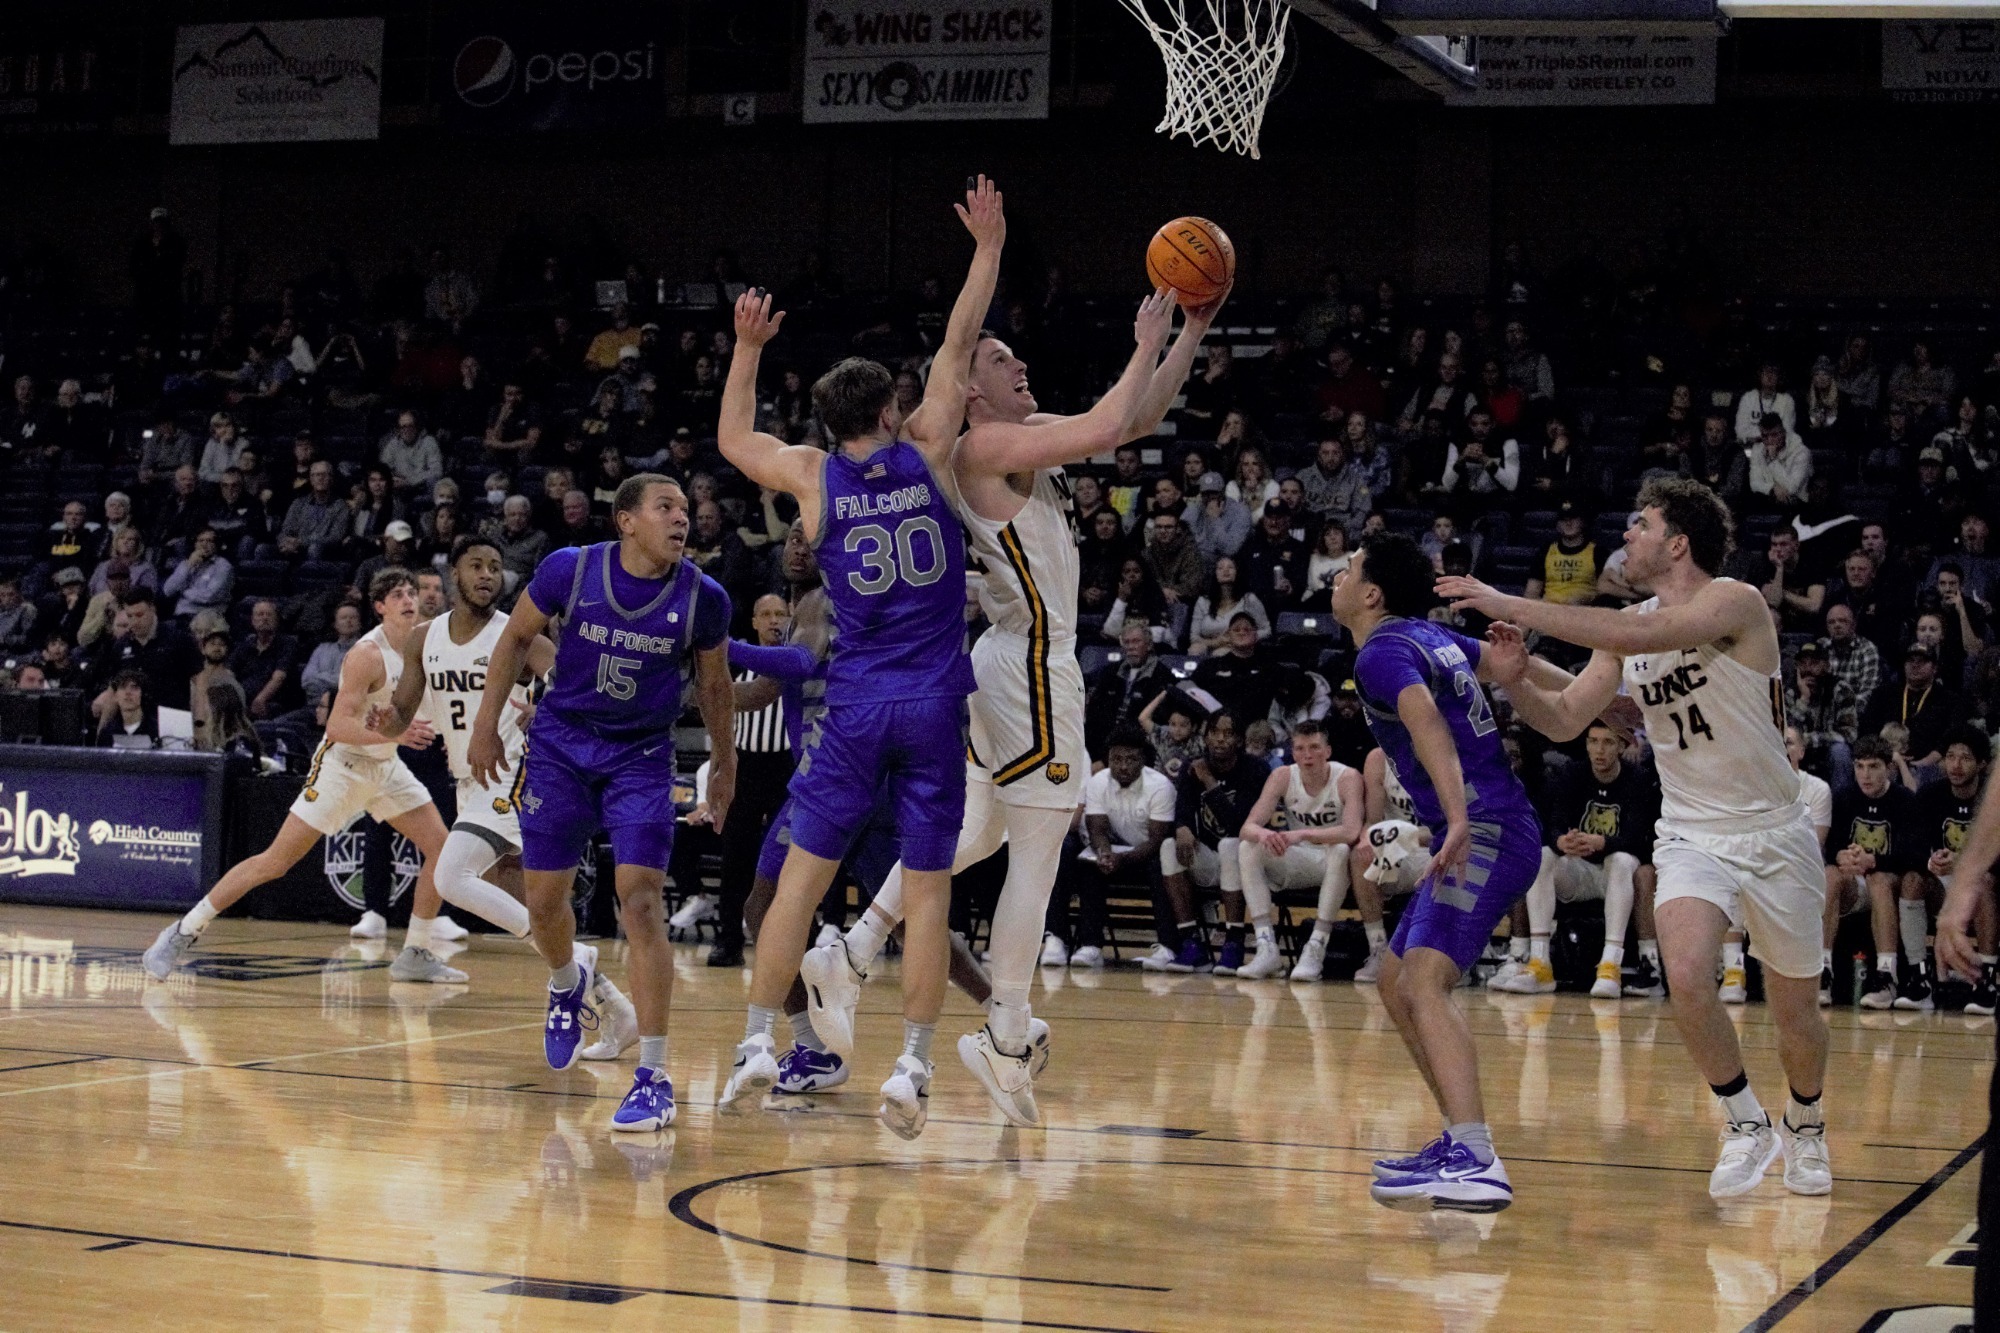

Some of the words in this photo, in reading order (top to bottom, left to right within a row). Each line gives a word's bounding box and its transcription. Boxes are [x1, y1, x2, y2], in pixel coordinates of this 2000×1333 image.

[855, 13, 932, 44] WING
[943, 9, 1043, 42] SHACK
[524, 41, 654, 93] pepsi
[819, 72, 882, 106] SEXY
[918, 68, 1033, 105] SAMMIES
[732, 100, 748, 118] C
[835, 484, 932, 520] FALCONS
[843, 515, 948, 596] 30
[578, 621, 607, 645] AIR
[611, 628, 675, 655] FORCE
[430, 669, 486, 692] UNC
[596, 653, 643, 701] 15
[1639, 663, 1708, 706] UNC
[450, 701, 466, 730] 2
[1669, 703, 1714, 750] 14
[114, 824, 146, 841] High
[148, 826, 203, 843] Country
